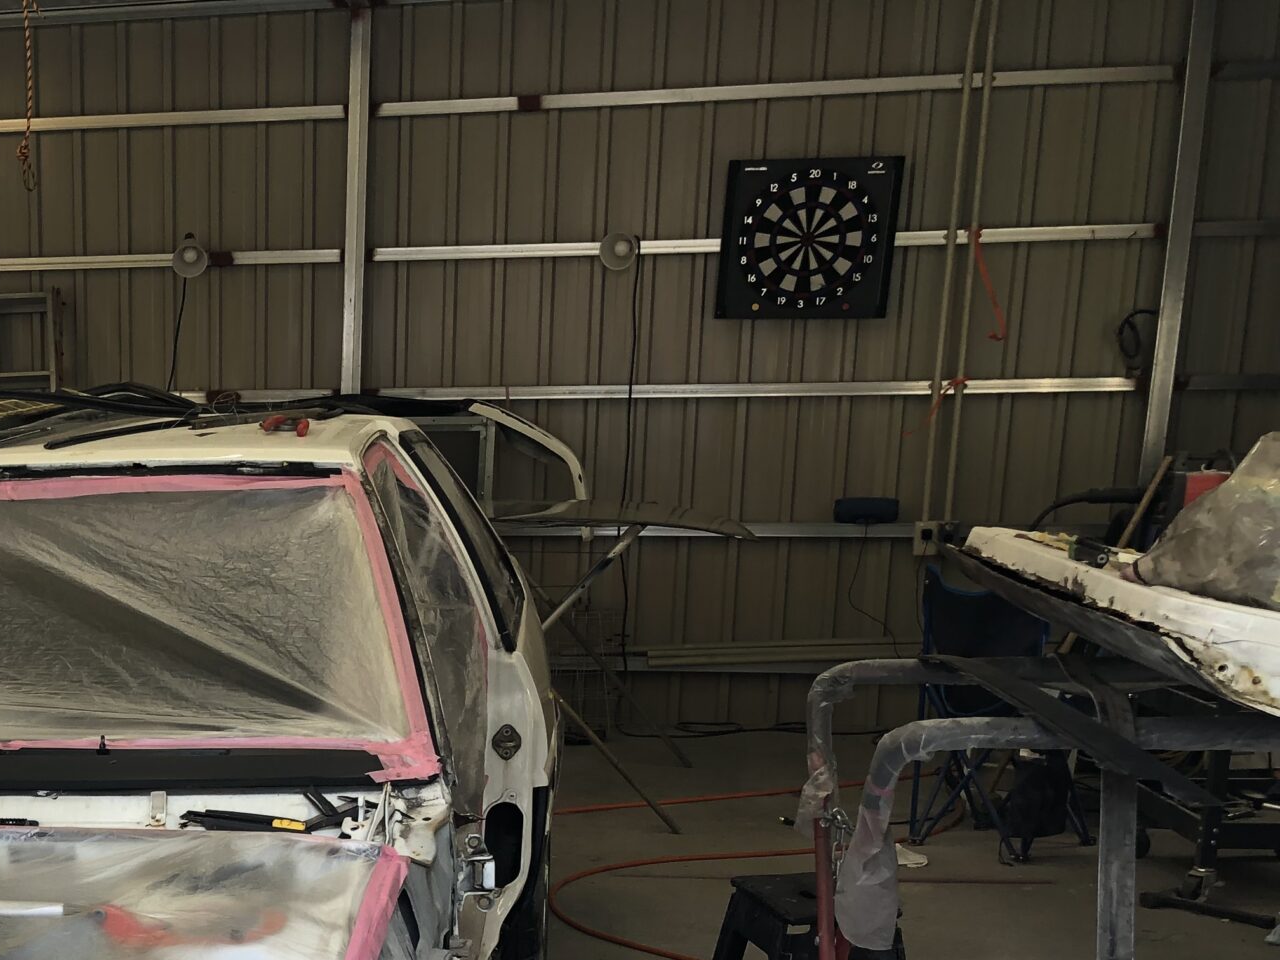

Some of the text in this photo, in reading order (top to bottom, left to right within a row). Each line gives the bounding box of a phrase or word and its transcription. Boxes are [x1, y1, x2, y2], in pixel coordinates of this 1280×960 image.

[790, 172, 798, 183] 5
[808, 168, 822, 179] 20
[770, 183, 779, 193] 12
[847, 180, 857, 190] 18
[755, 198, 763, 208] 9
[861, 195, 869, 204] 4
[744, 215, 753, 225] 14
[868, 213, 878, 223] 13
[738, 236, 747, 245] 11
[870, 233, 877, 243] 6
[740, 255, 747, 265] 8
[863, 254, 873, 264] 10
[747, 273, 757, 283] 16
[852, 272, 861, 282] 15
[760, 287, 768, 297] 7
[836, 287, 844, 296] 2
[777, 296, 787, 305] 19
[797, 299, 804, 309] 3
[816, 296, 826, 306] 17
